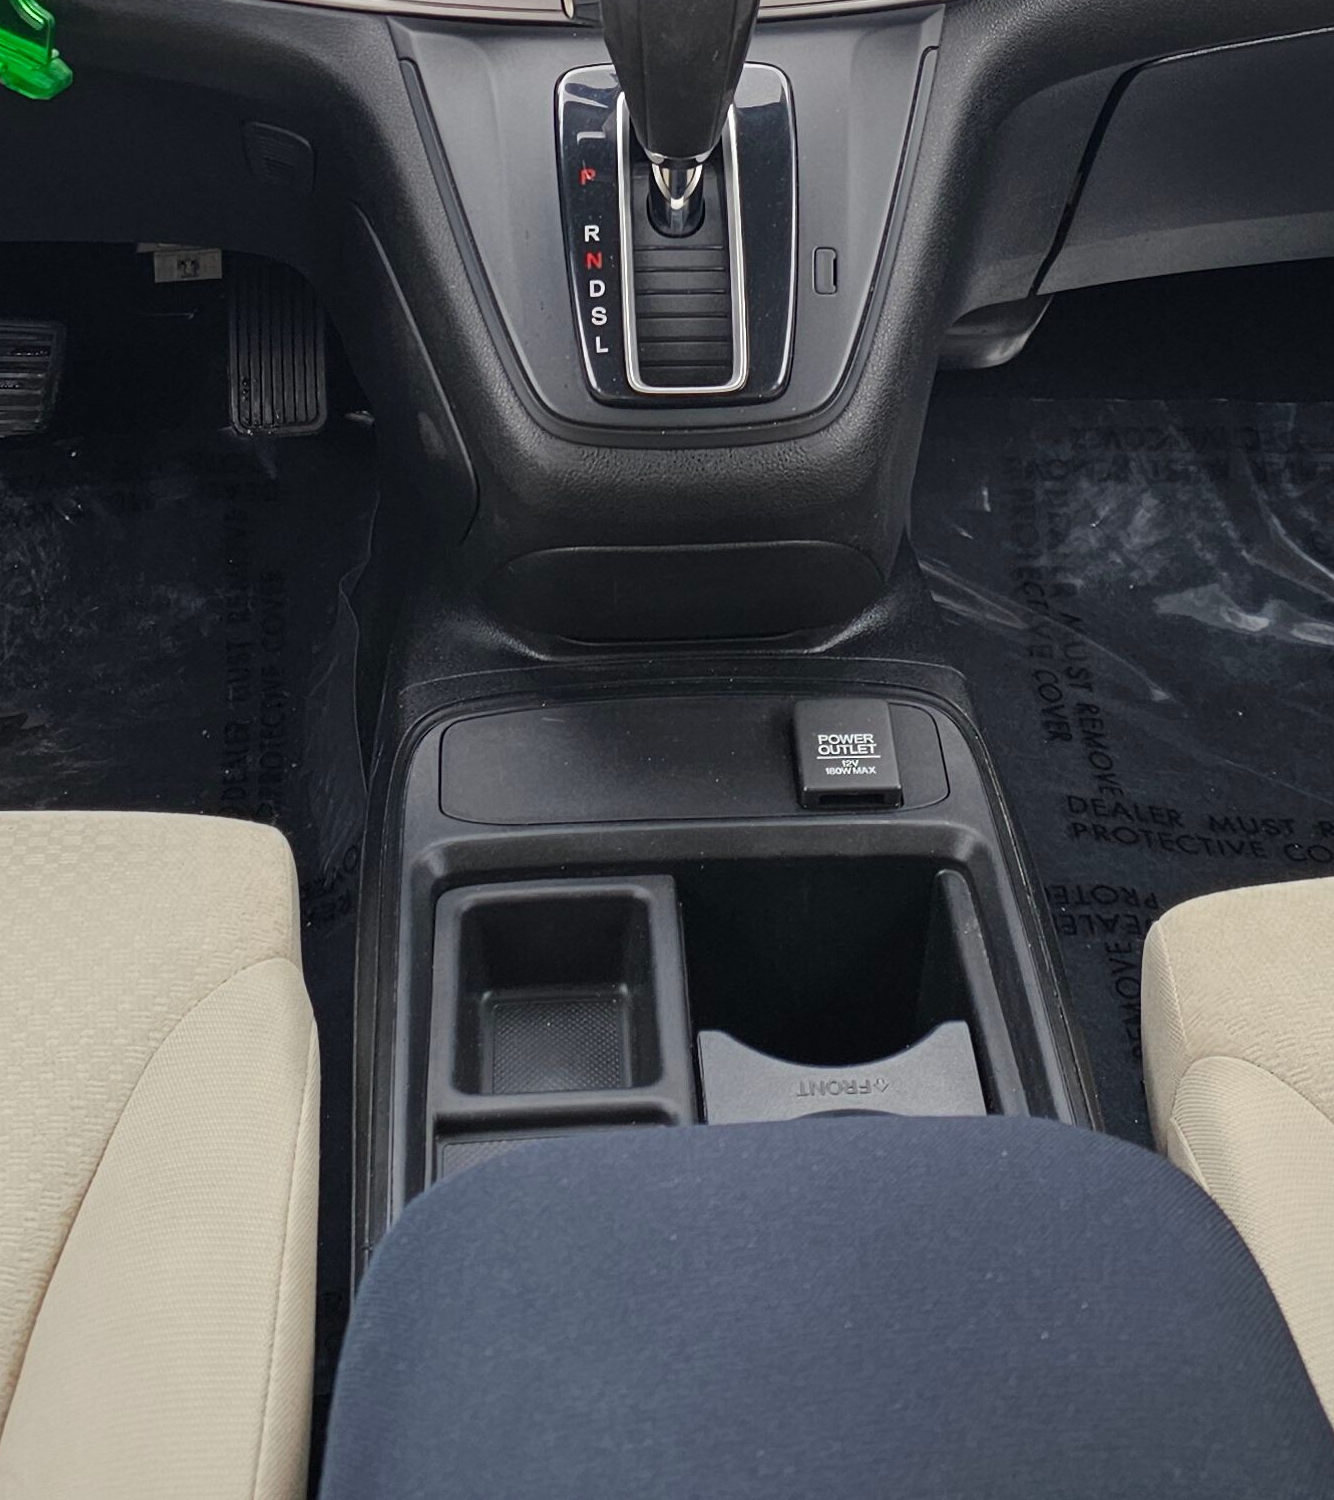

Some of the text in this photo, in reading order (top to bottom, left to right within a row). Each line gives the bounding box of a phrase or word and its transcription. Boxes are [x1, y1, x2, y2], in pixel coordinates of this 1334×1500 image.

[579, 167, 596, 185] P
[584, 225, 600, 242] R
[586, 252, 603, 270] N
[589, 280, 605, 298] D
[591, 306, 608, 326] S
[595, 336, 609, 353] L
[817, 733, 875, 745] POWER
[817, 744, 878, 755] OUTLET
[825, 766, 878, 775] 180W MAX
[841, 759, 860, 768] 12V
[1065, 793, 1185, 830] DEALER
[1203, 813, 1297, 841] MUST
[1067, 821, 1268, 860] PROTECTIVE
[796, 1079, 872, 1098] FRONT
